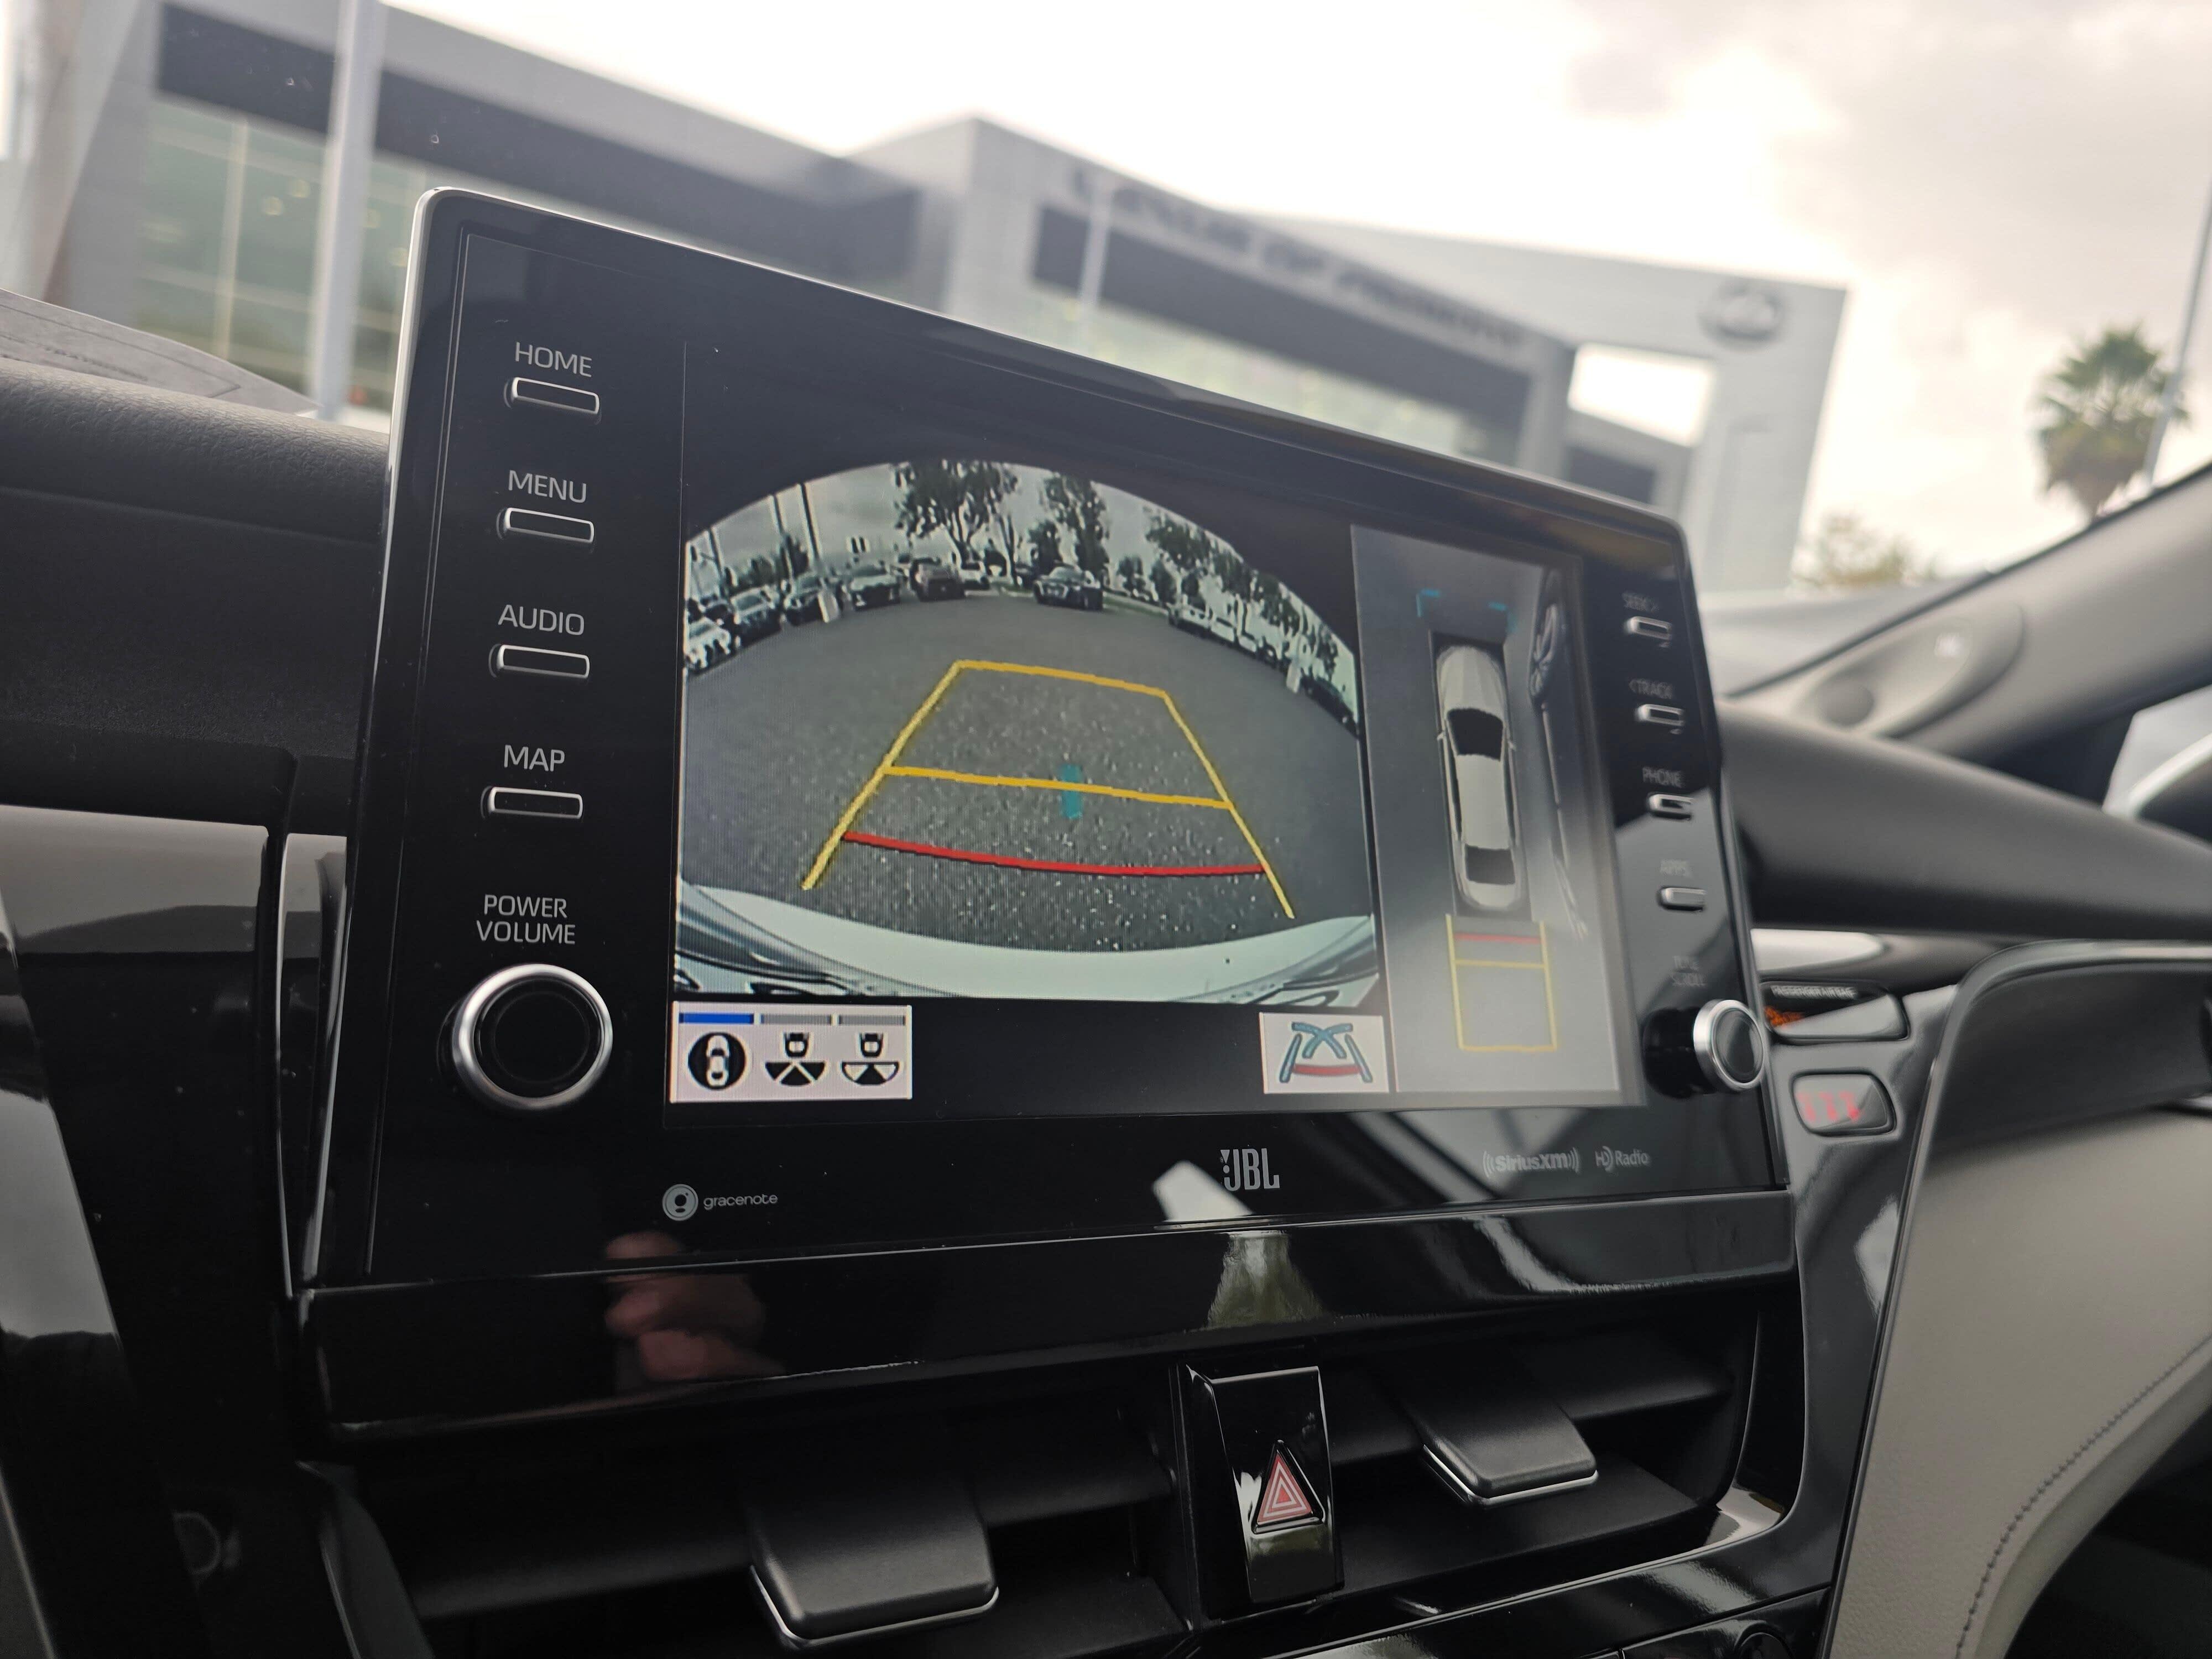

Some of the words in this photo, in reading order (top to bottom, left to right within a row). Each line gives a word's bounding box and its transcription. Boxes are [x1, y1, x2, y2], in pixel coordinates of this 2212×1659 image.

[514, 342, 592, 377] HOME
[508, 469, 587, 503] MENU
[498, 604, 585, 635] AUDIO
[504, 744, 565, 771] MAP
[484, 894, 567, 918] POWER
[476, 920, 576, 944] VOLUME
[1222, 1148, 1280, 1191] JBL
[1615, 1149, 1650, 1166] Radio
[703, 1193, 779, 1211] gracenote
